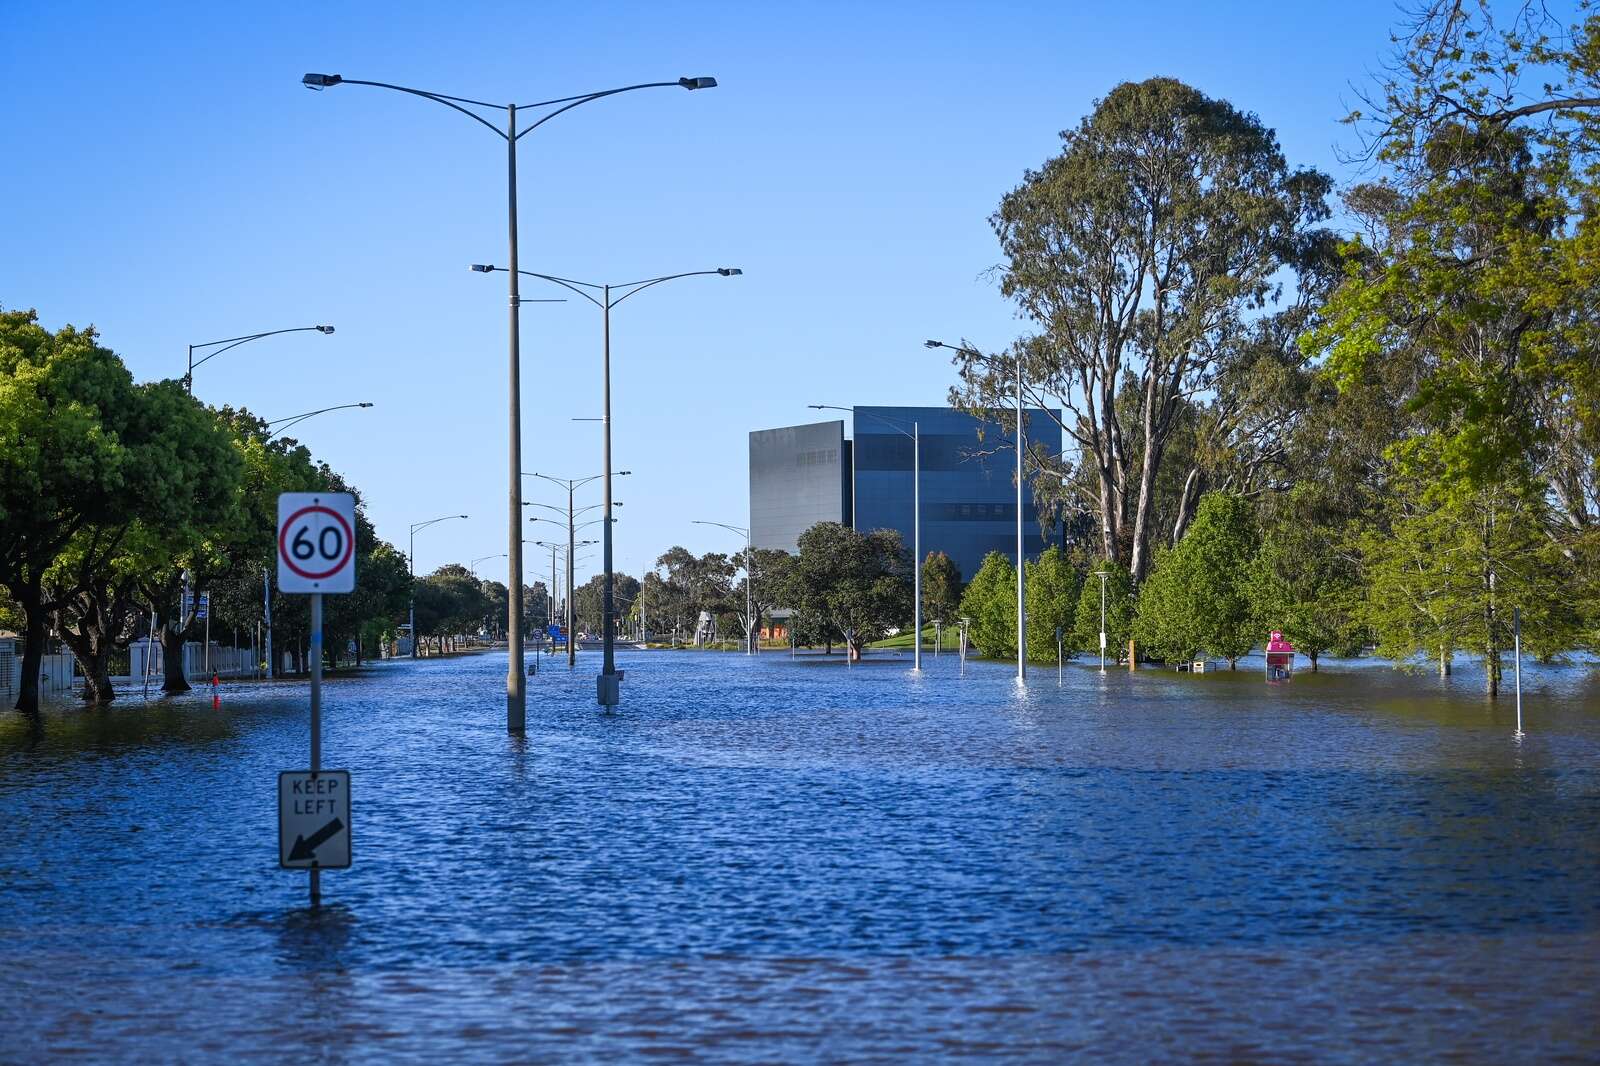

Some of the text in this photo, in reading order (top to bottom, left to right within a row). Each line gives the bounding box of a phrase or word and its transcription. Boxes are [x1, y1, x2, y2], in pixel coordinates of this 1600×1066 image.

[292, 525, 342, 560] 60
[292, 779, 339, 795] KEEP
[294, 799, 337, 815] LEFT
